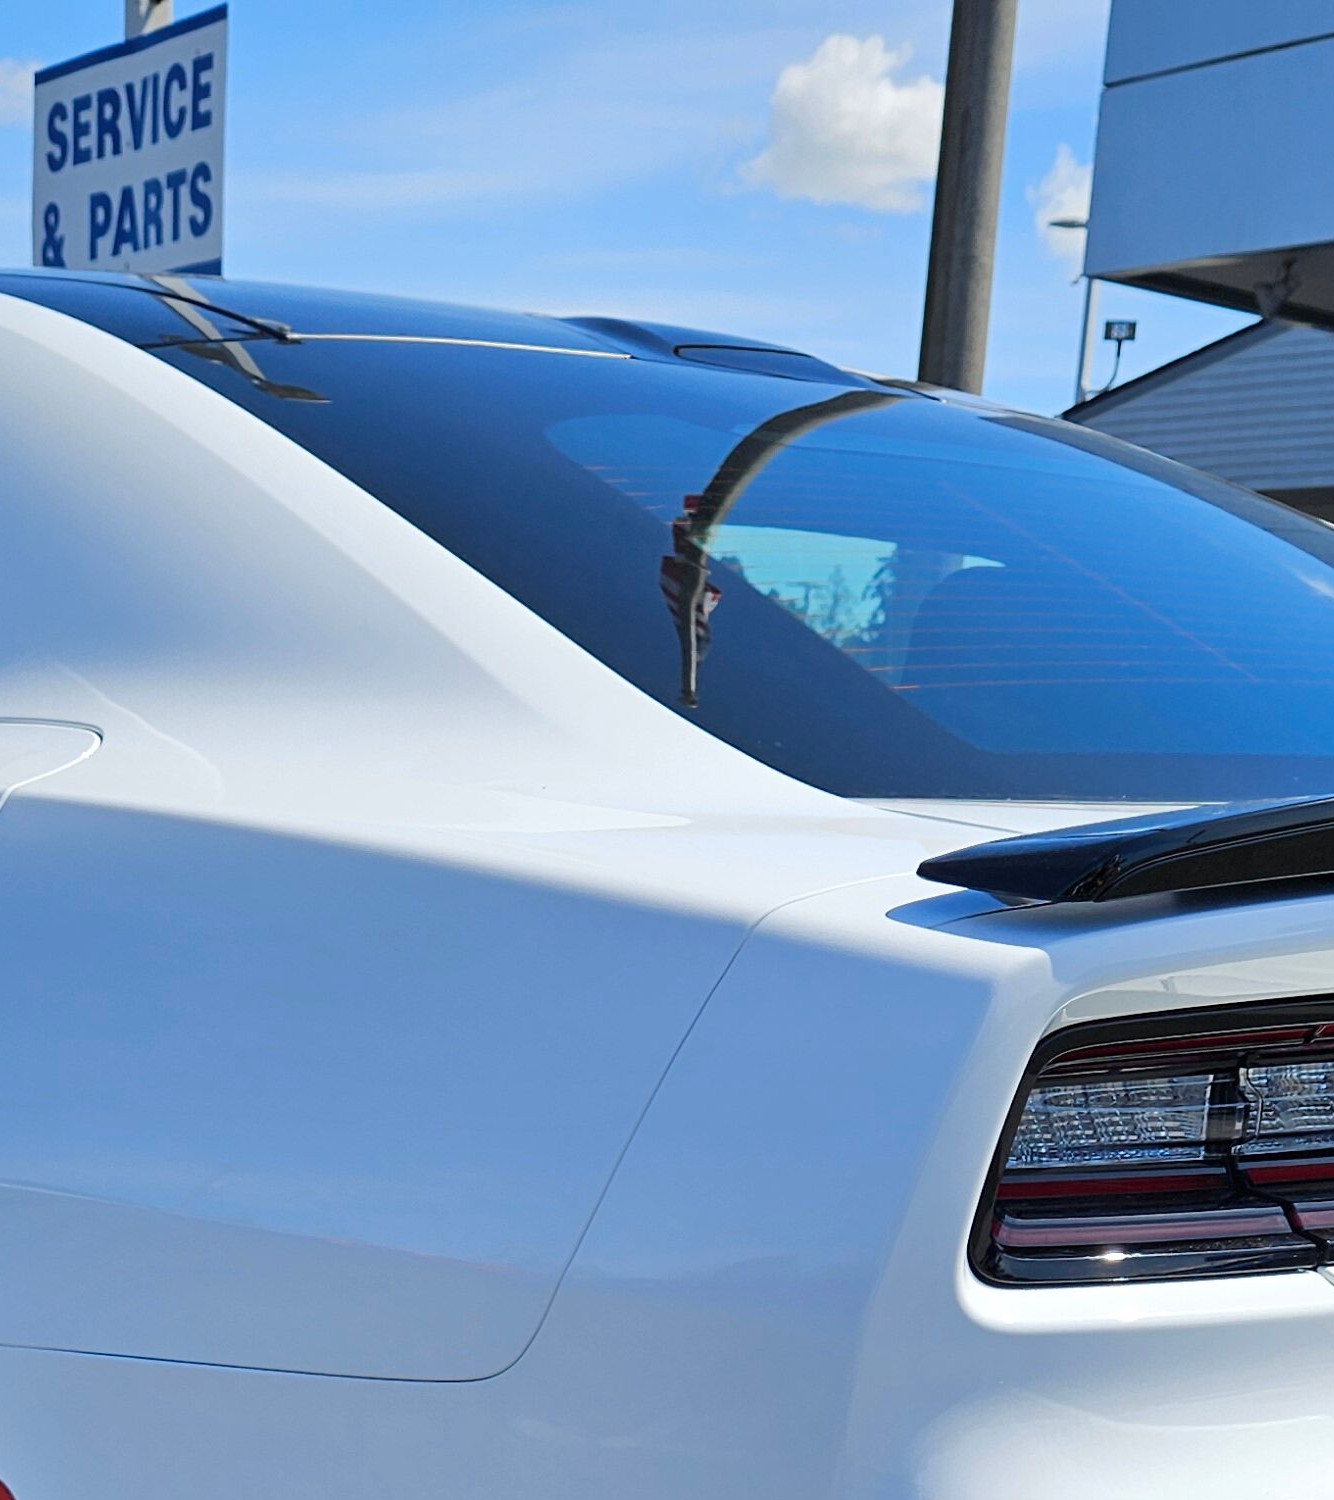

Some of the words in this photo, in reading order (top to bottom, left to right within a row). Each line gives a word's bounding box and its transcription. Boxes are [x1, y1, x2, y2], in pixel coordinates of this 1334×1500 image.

[46, 52, 214, 173] SERVICE
[42, 202, 66, 267] &
[89, 161, 213, 261] PARTS
